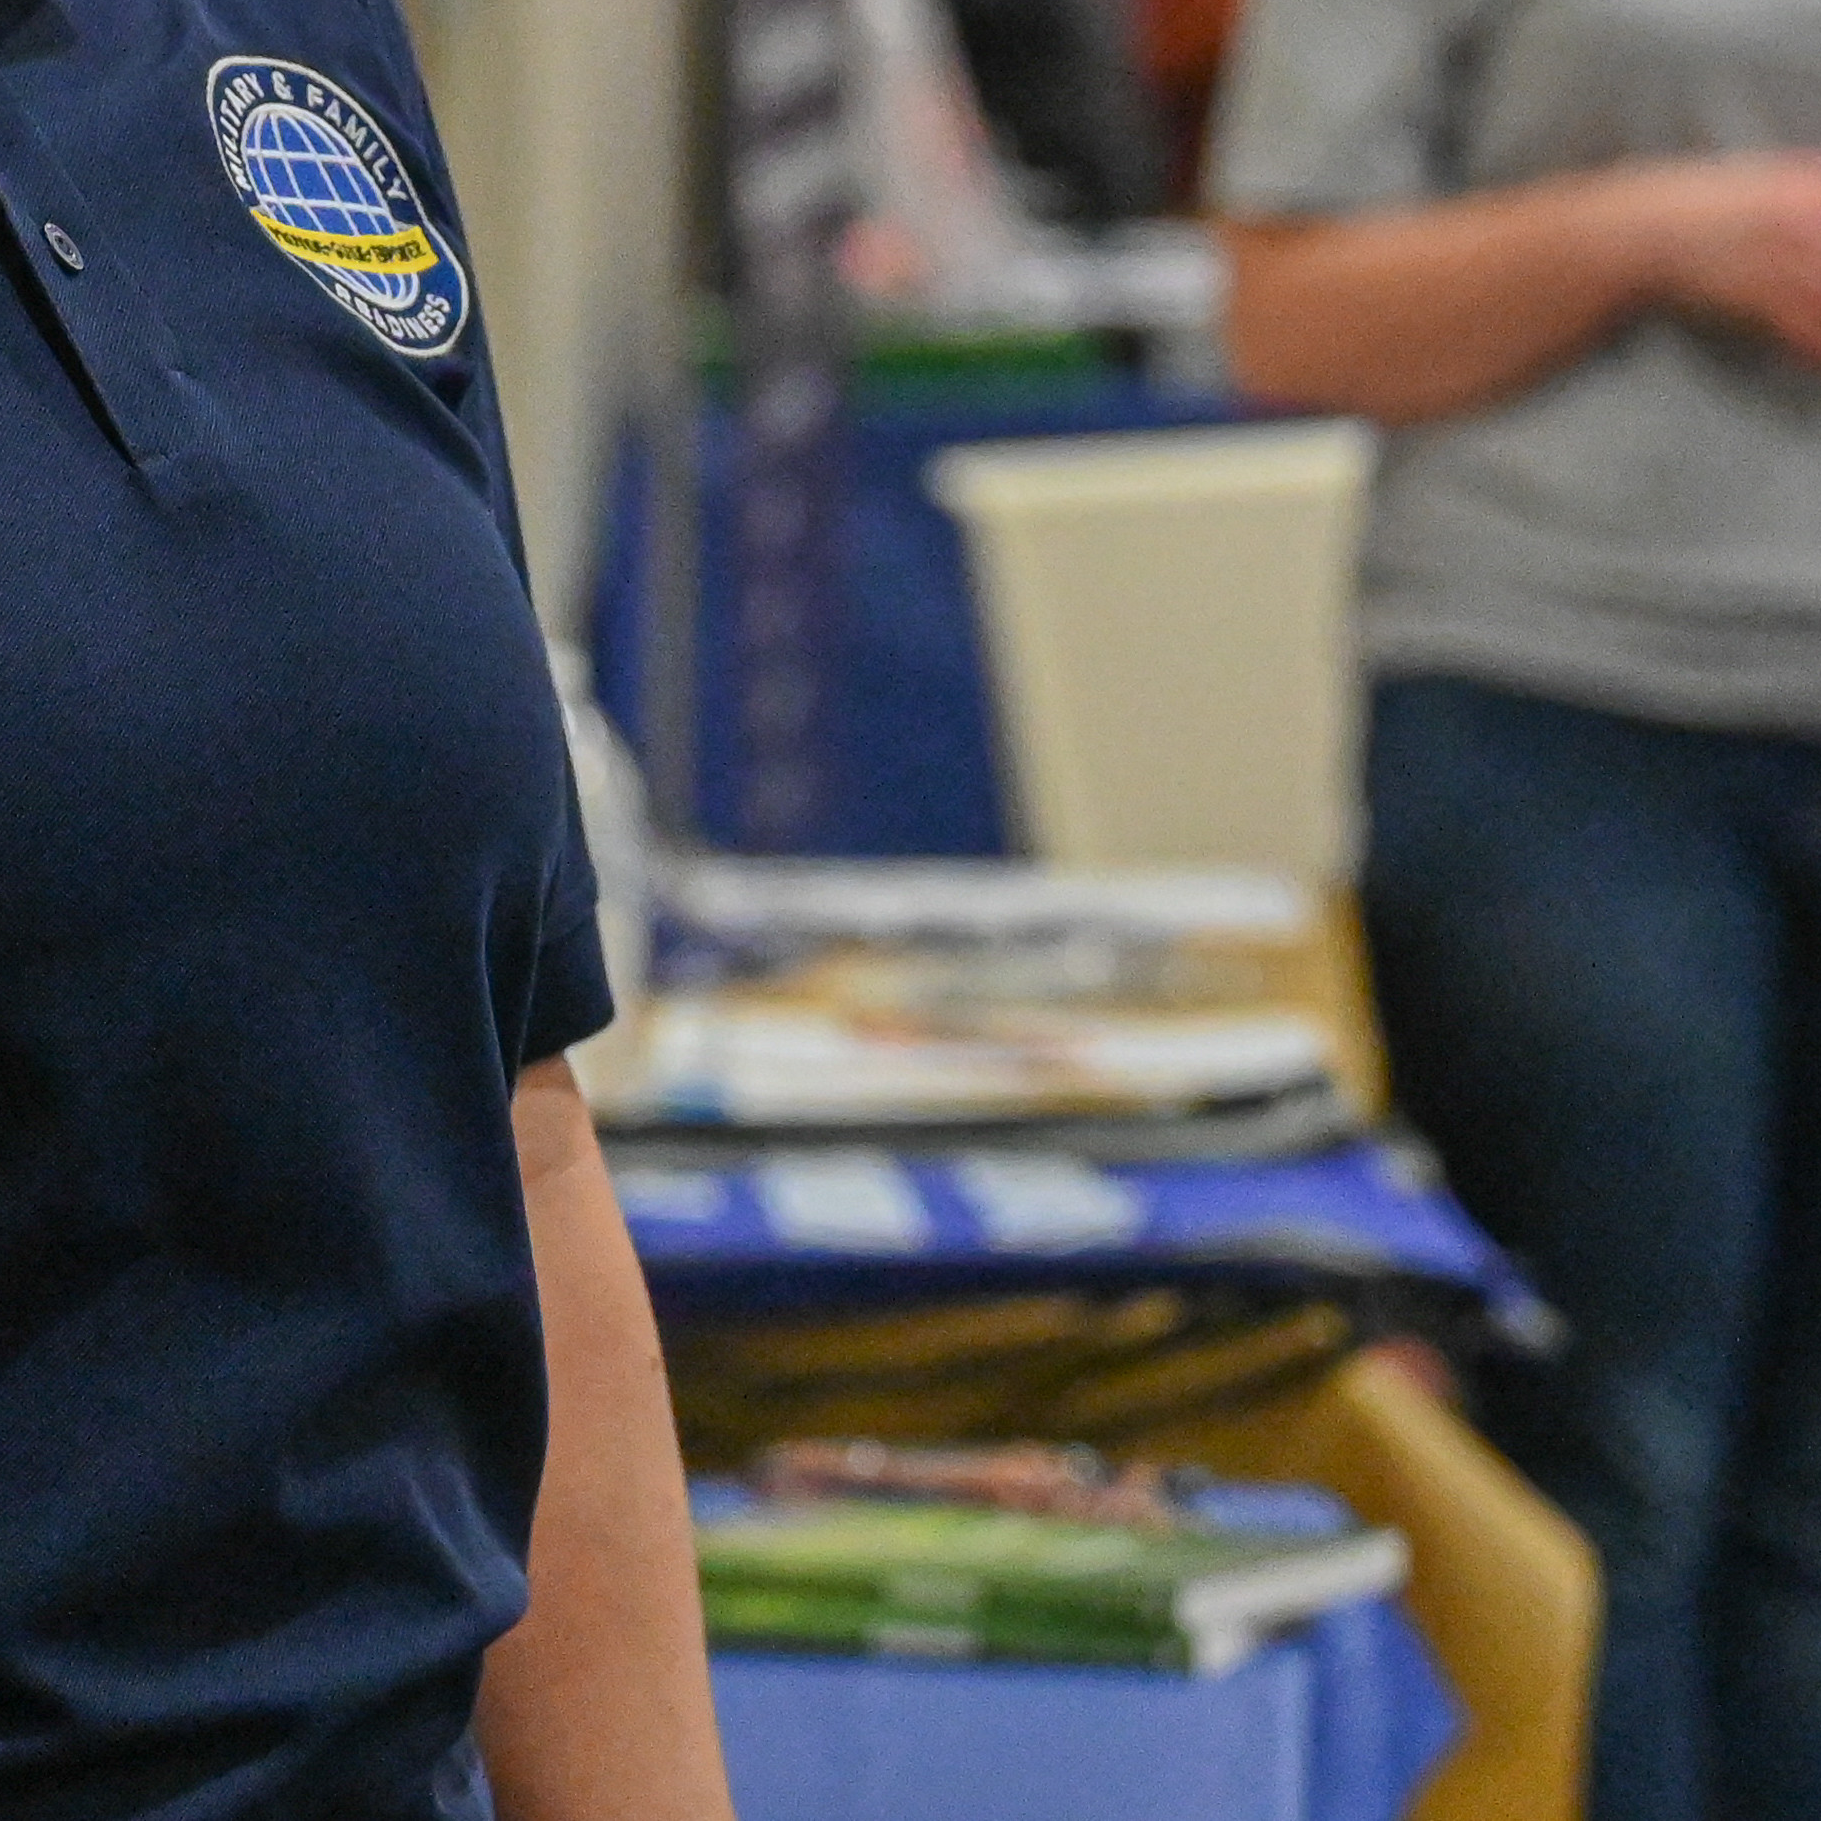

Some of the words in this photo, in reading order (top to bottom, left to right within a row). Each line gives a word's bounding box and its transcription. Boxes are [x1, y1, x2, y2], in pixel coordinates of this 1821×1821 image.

[219, 72, 265, 192] MILITARY
[271, 70, 295, 101] &
[306, 82, 409, 201] FAMILY
